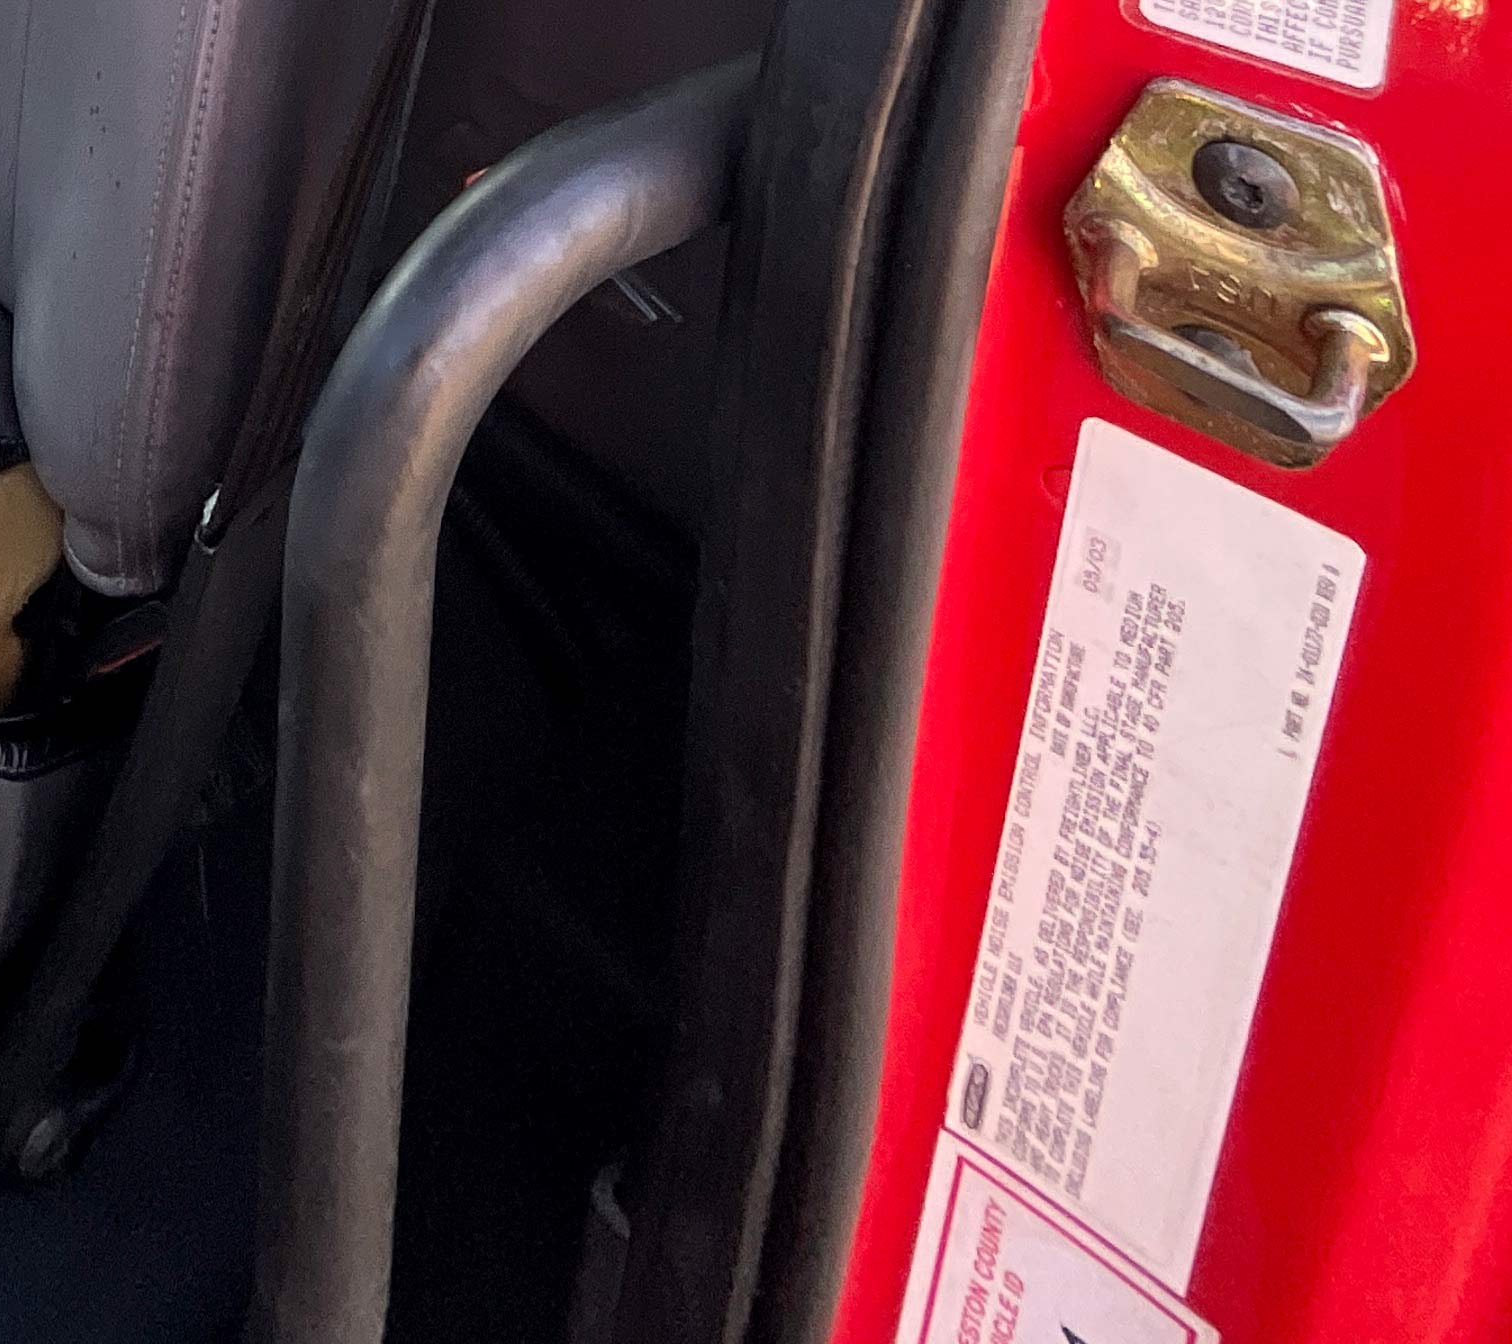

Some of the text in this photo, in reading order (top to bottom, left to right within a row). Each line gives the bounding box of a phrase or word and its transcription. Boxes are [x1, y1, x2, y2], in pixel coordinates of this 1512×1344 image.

[1255, 0, 1283, 44] THIS
[1308, 37, 1334, 63] IF
[1119, 591, 1145, 648] MEDIUM
[1130, 584, 1168, 691] MANUFACTURER
[1114, 651, 1132, 671] TO
[1154, 638, 1177, 675] PART
[1146, 679, 1167, 710] CFR
[1094, 678, 1126, 764] APPLICABLE
[1108, 748, 1132, 792] FINAL
[1136, 739, 1154, 759] TO
[1079, 769, 1107, 837] EMISSION
[1102, 796, 1121, 822] THE
[1114, 765, 1148, 859] CONFORMANCE
[973, 963, 997, 1028] VEHICLE
[998, 824, 1026, 902] EMISSION
[1015, 749, 1041, 818] CONTROL
[1030, 630, 1065, 741] INFORMATION
[1038, 870, 1065, 943] DELIVERED
[1059, 742, 1093, 842] FREIGHTLINER
[973, 1195, 1007, 1280] COUNTY
